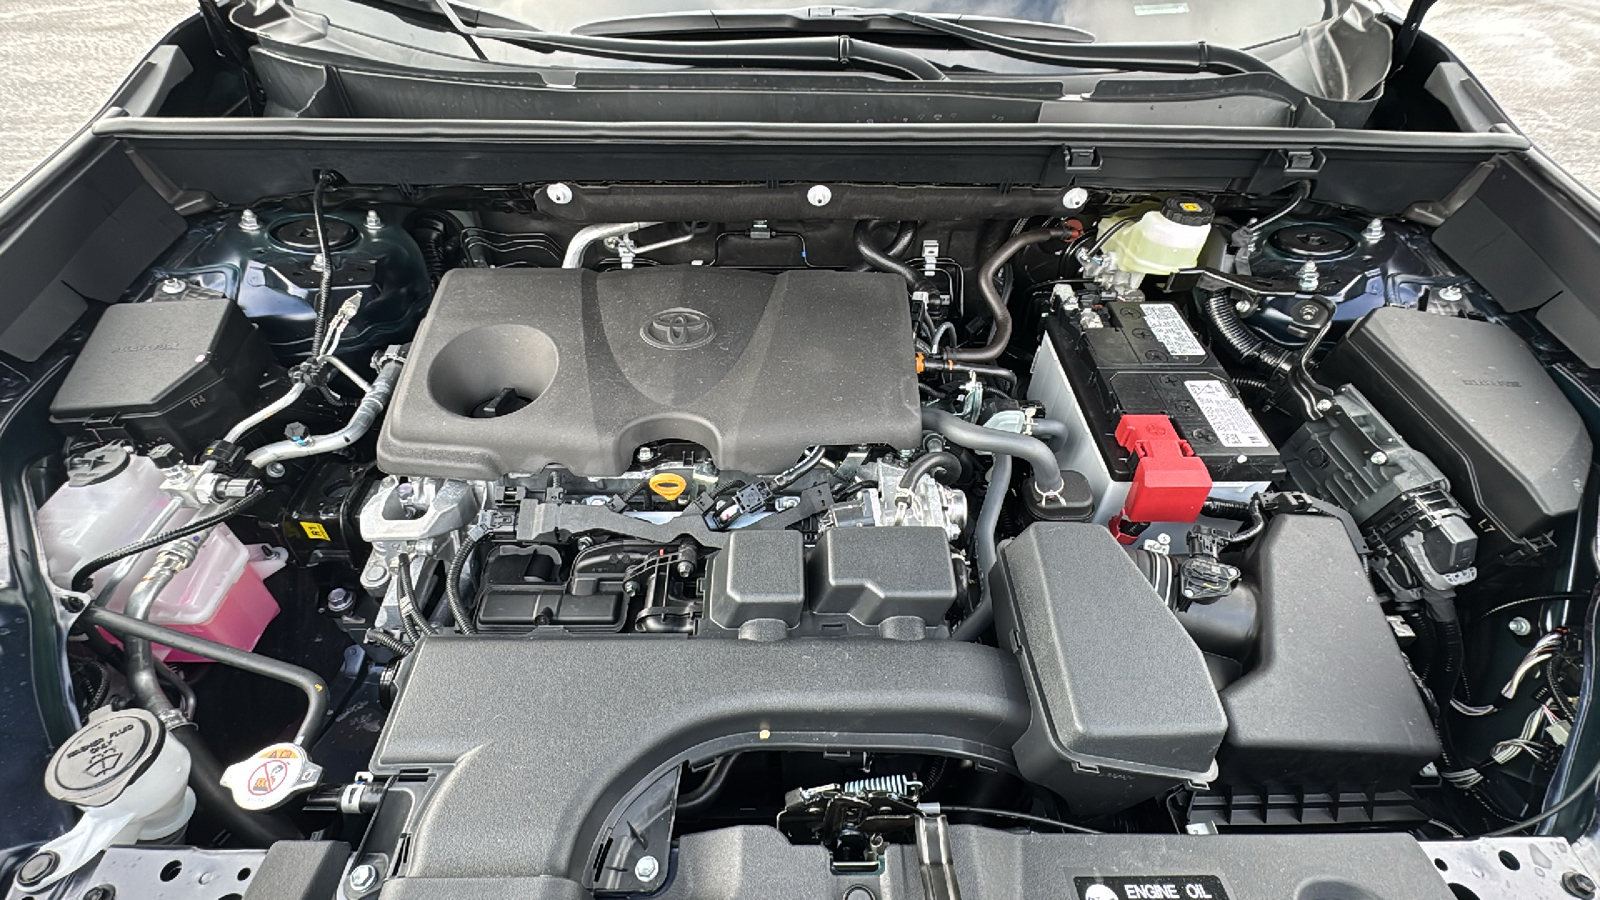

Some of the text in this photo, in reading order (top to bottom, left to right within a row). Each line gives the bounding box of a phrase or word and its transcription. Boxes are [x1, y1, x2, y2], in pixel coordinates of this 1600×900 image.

[189, 394, 206, 408] R4
[1478, 518, 1496, 533] L7
[1124, 884, 1212, 899] ENGINE OIL
